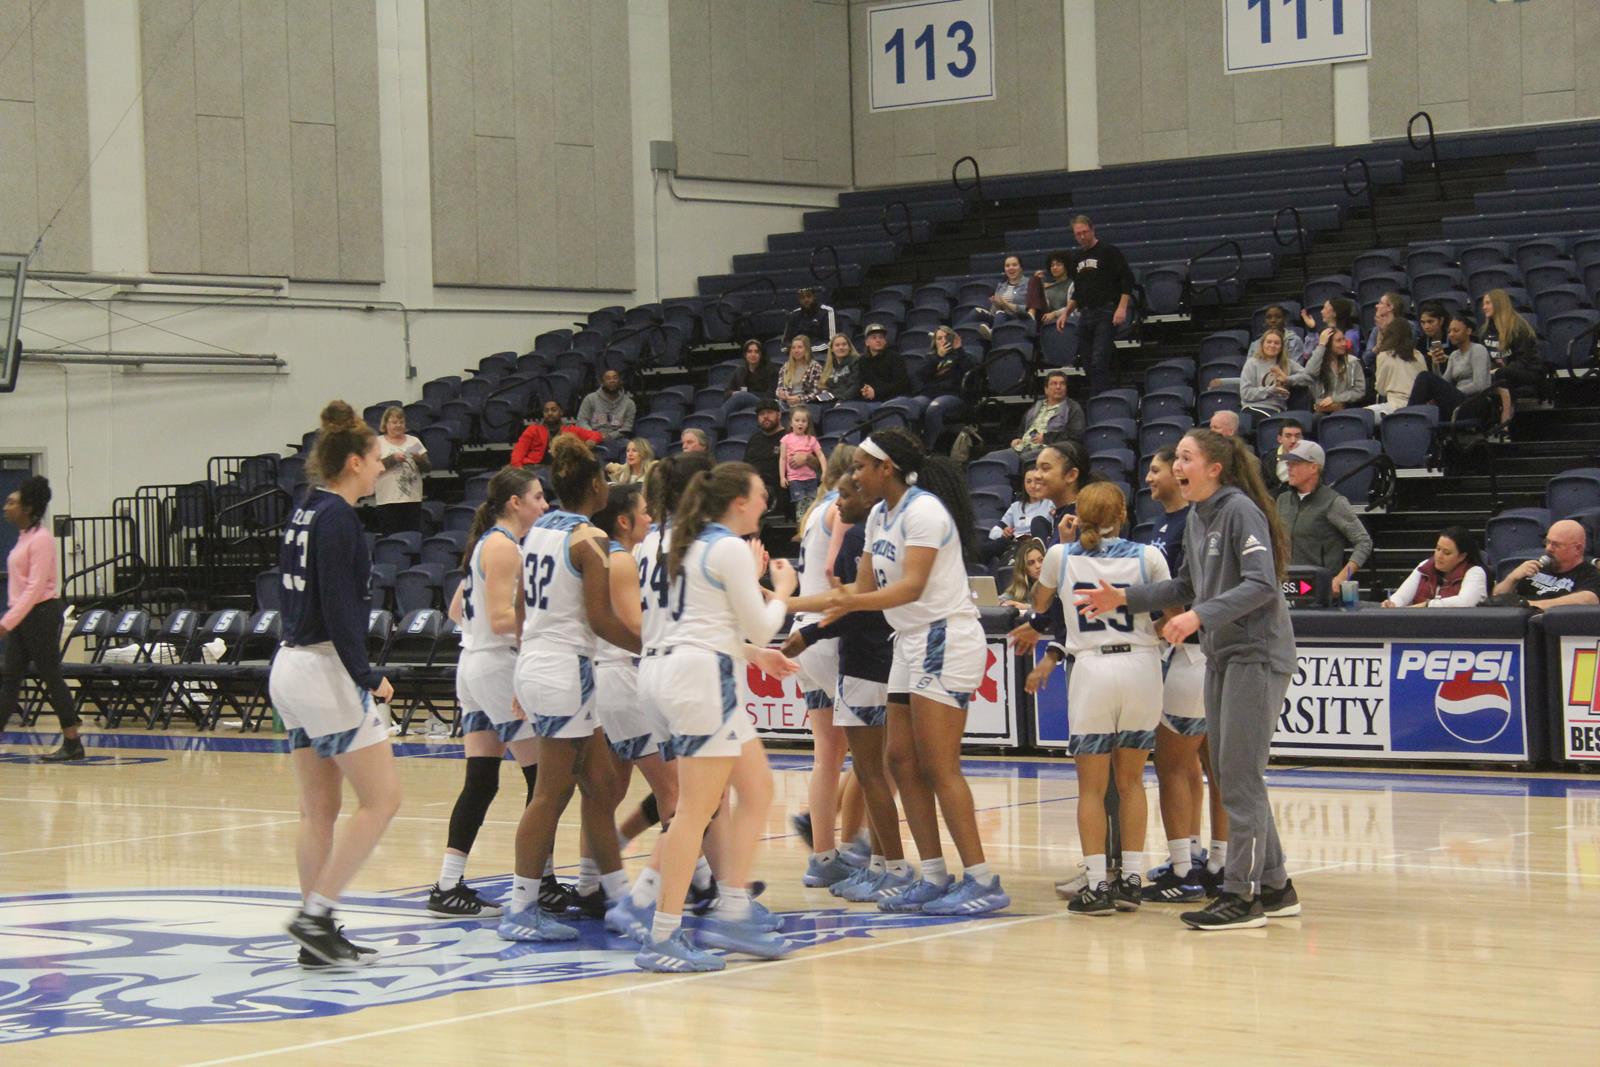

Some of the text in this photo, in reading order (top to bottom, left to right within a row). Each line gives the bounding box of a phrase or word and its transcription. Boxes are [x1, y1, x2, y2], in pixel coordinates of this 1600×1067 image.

[884, 20, 977, 85] 113
[524, 552, 556, 611] 32
[1292, 656, 1384, 688] STATE
[1396, 650, 1514, 682] PEPSI
